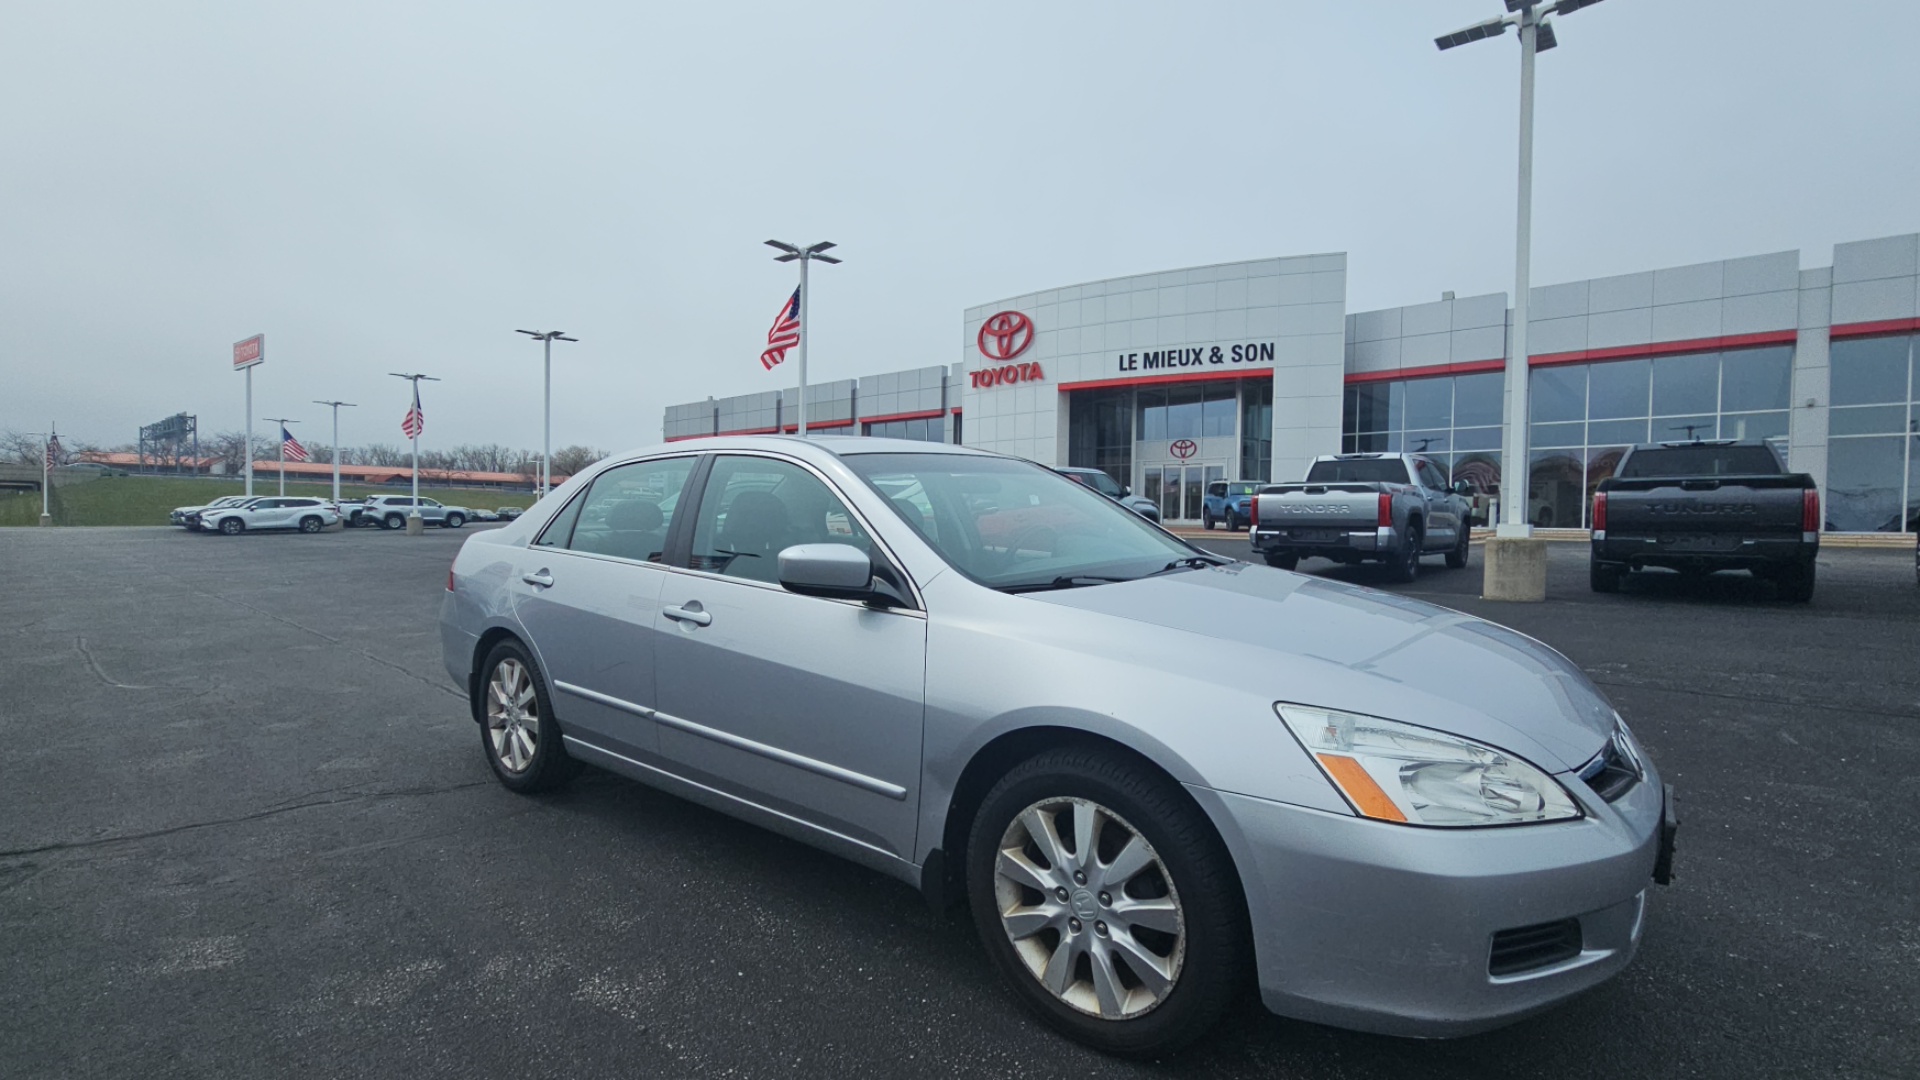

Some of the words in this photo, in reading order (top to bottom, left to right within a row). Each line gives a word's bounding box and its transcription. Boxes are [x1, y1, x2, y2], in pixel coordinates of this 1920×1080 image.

[1119, 353, 1137, 371] LE
[1143, 347, 1203, 370] MIEUX
[1208, 346, 1224, 364] &
[1231, 342, 1275, 363] SON
[969, 362, 1044, 388] TOYOTA
[1280, 504, 1350, 514] TUNDRA
[1644, 503, 1757, 515] TUNDRA
